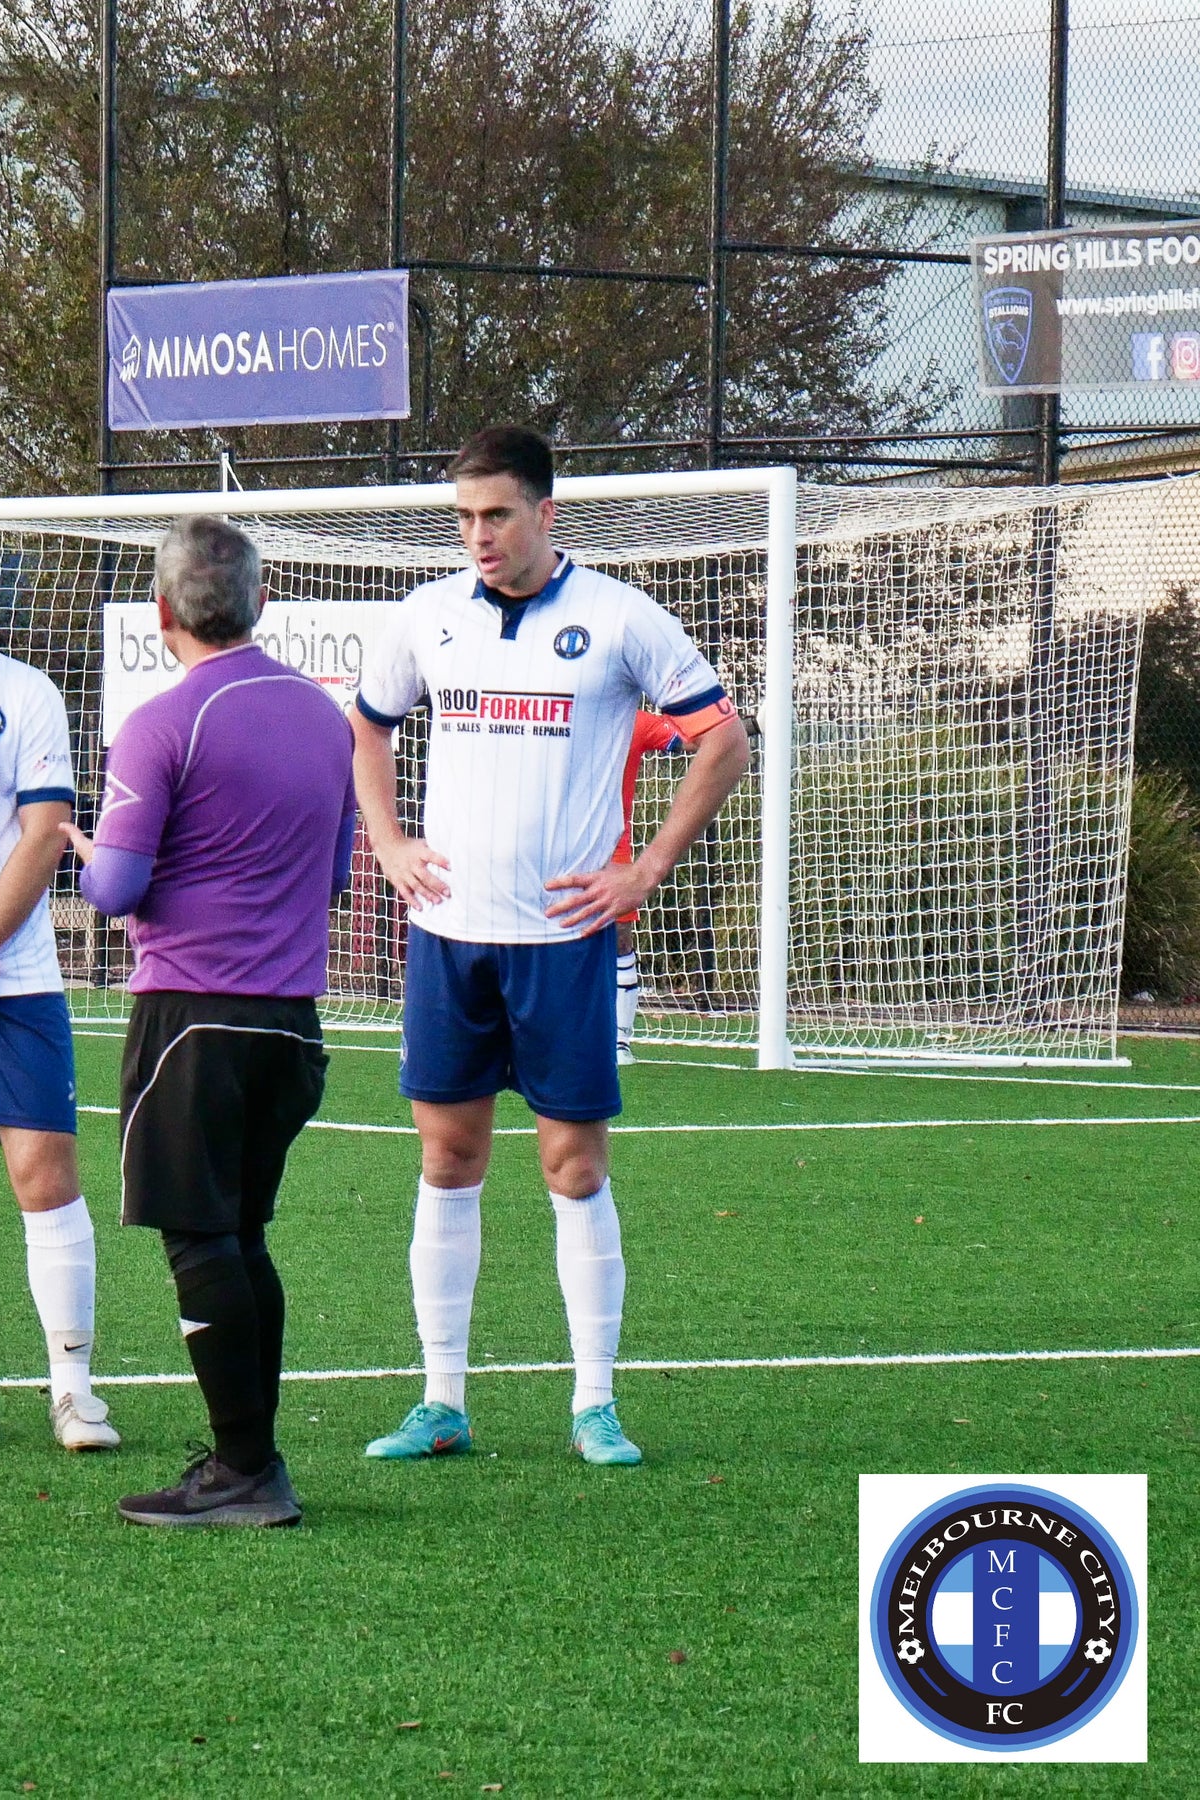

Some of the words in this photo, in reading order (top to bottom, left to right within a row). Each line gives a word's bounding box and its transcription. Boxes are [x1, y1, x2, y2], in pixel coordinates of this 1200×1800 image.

[984, 243, 1071, 274] SPRING
[1075, 239, 1142, 270] HILLS
[1147, 234, 1200, 266] FOO
[988, 305, 1030, 318] STALLIONS
[145, 330, 274, 379] MIMOSA
[253, 615, 363, 692] mbing
[437, 688, 478, 711] 1800
[480, 697, 574, 723] FORKLIFT
[456, 722, 481, 733] SALES
[488, 723, 525, 736] SERVICE
[533, 725, 571, 738] REPAIRS
